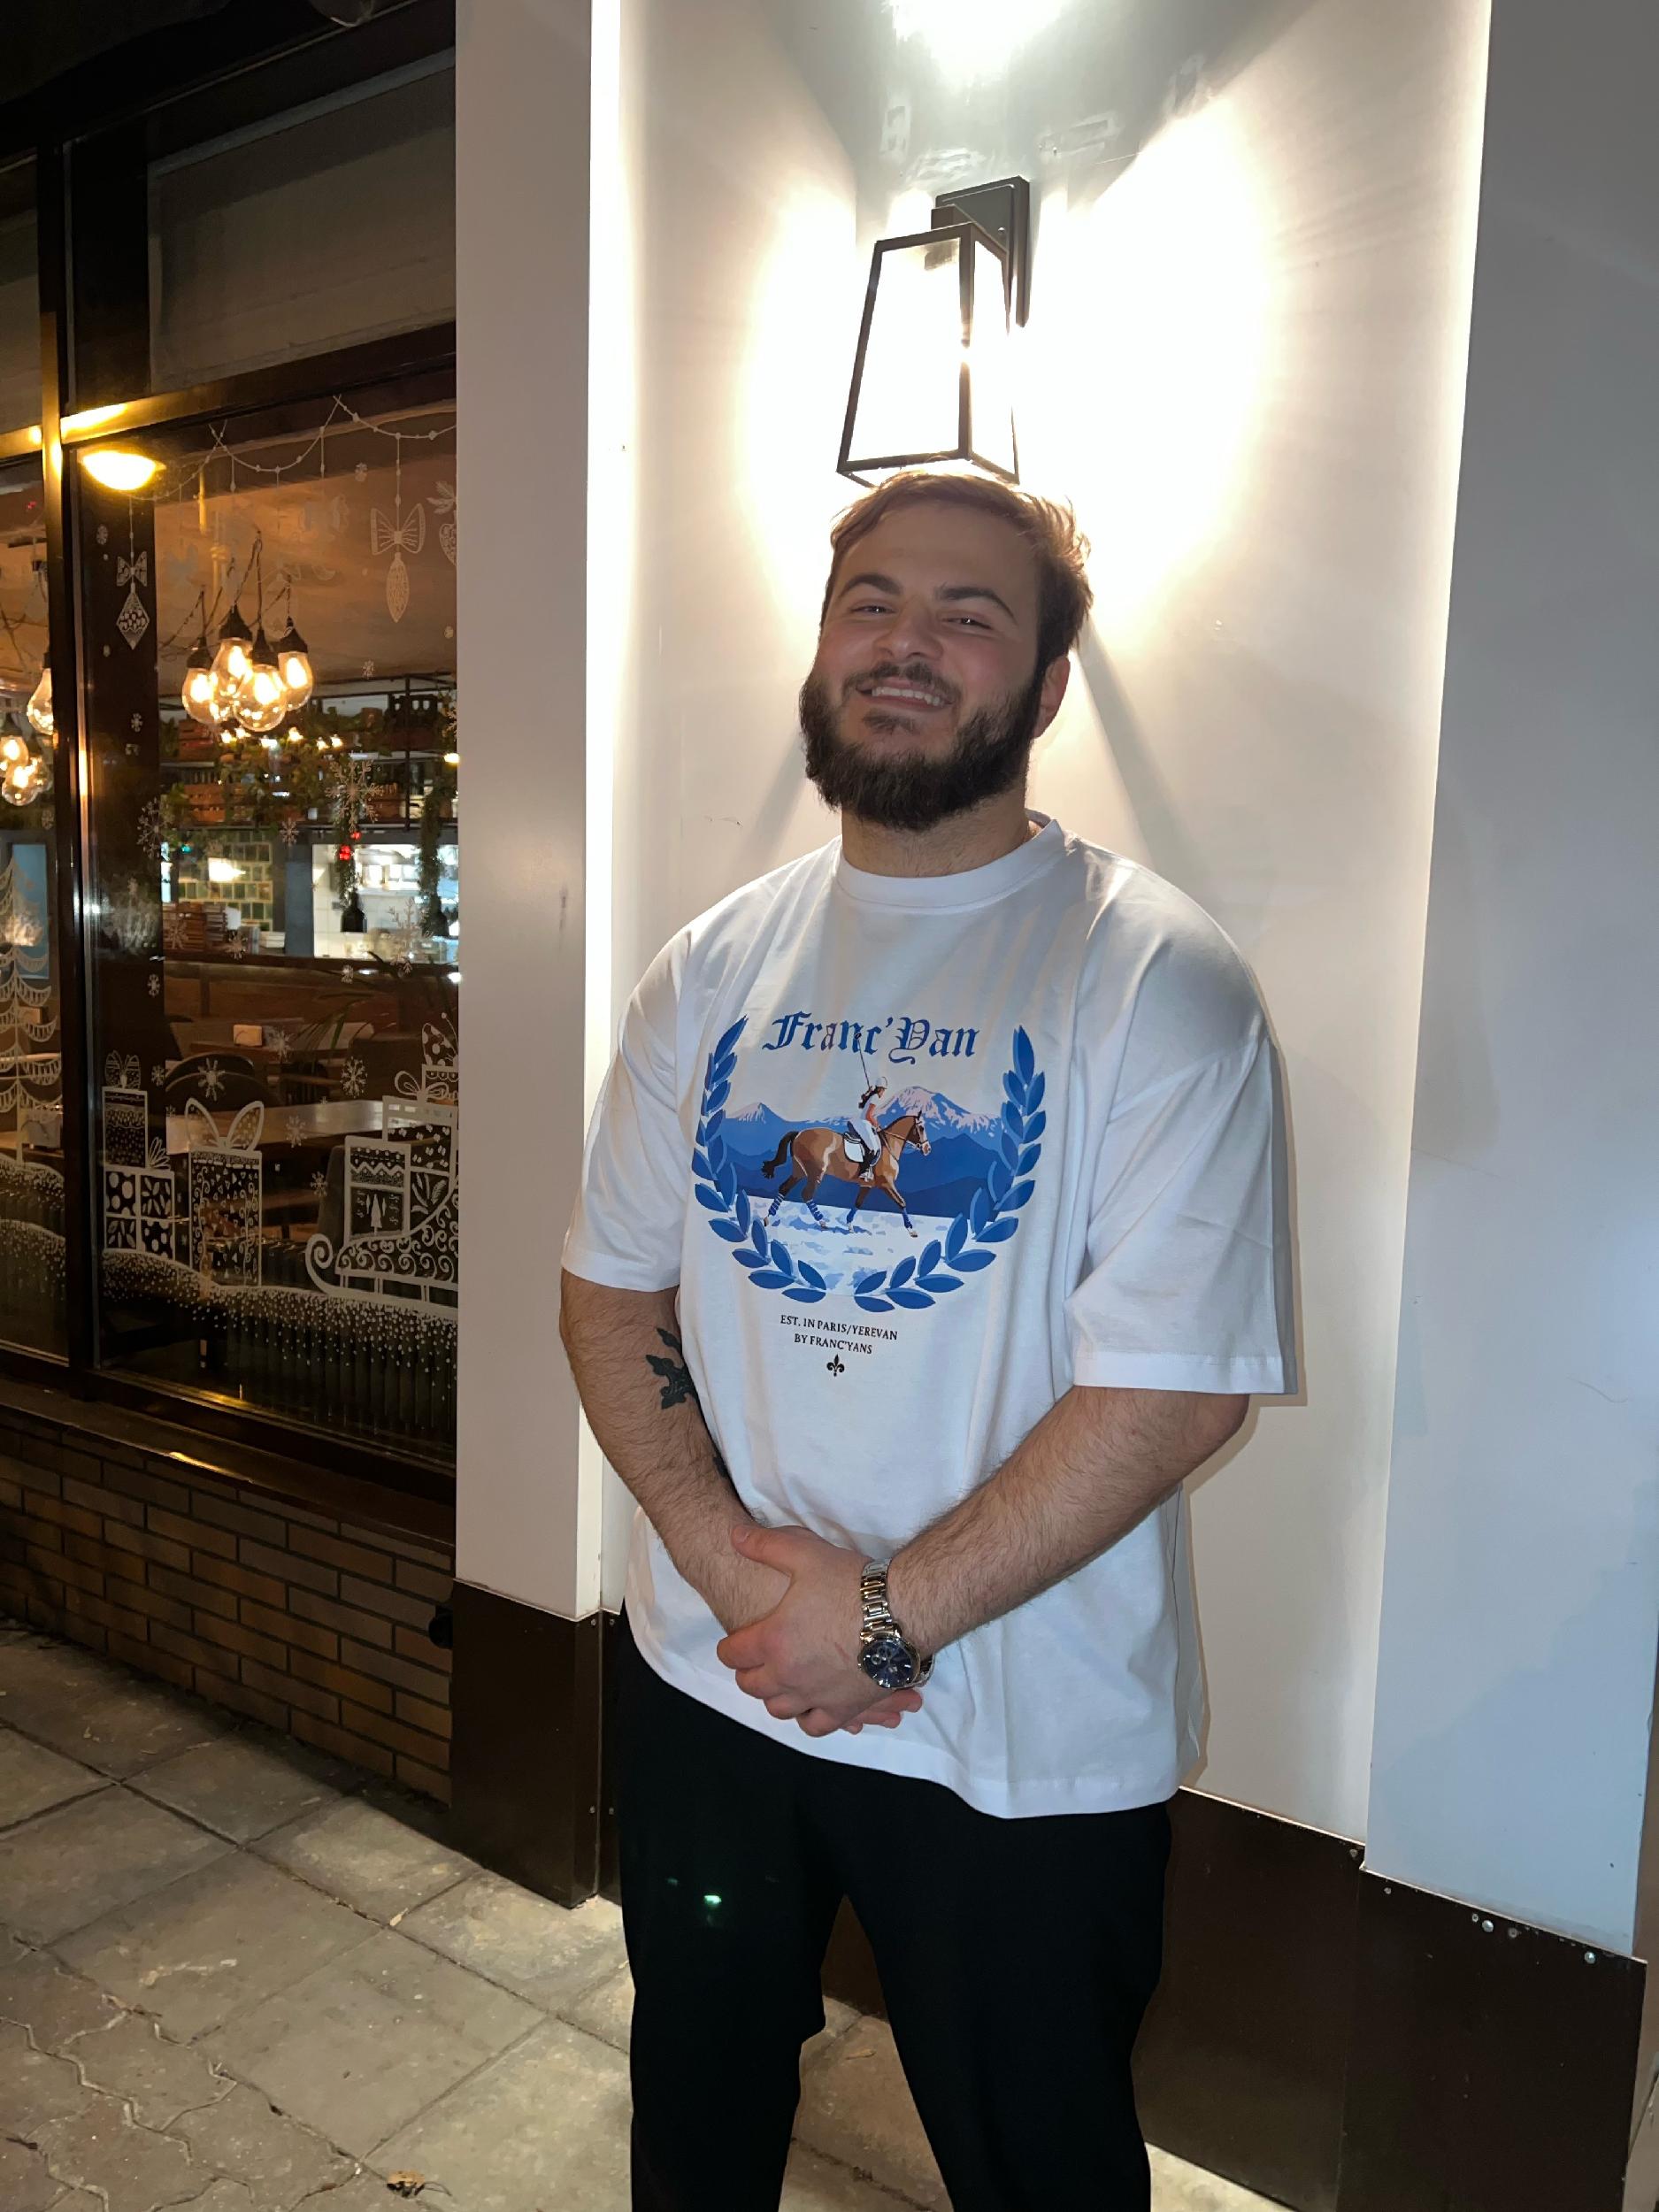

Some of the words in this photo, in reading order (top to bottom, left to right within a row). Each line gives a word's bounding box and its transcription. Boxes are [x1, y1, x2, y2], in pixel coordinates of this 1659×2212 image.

[762, 1010, 980, 1065] Franc'Yan
[780, 1314, 801, 1326] EST.
[803, 1318, 816, 1328] IN
[818, 1320, 898, 1340] PARIS/YEREVAN
[795, 1333, 808, 1344] BY
